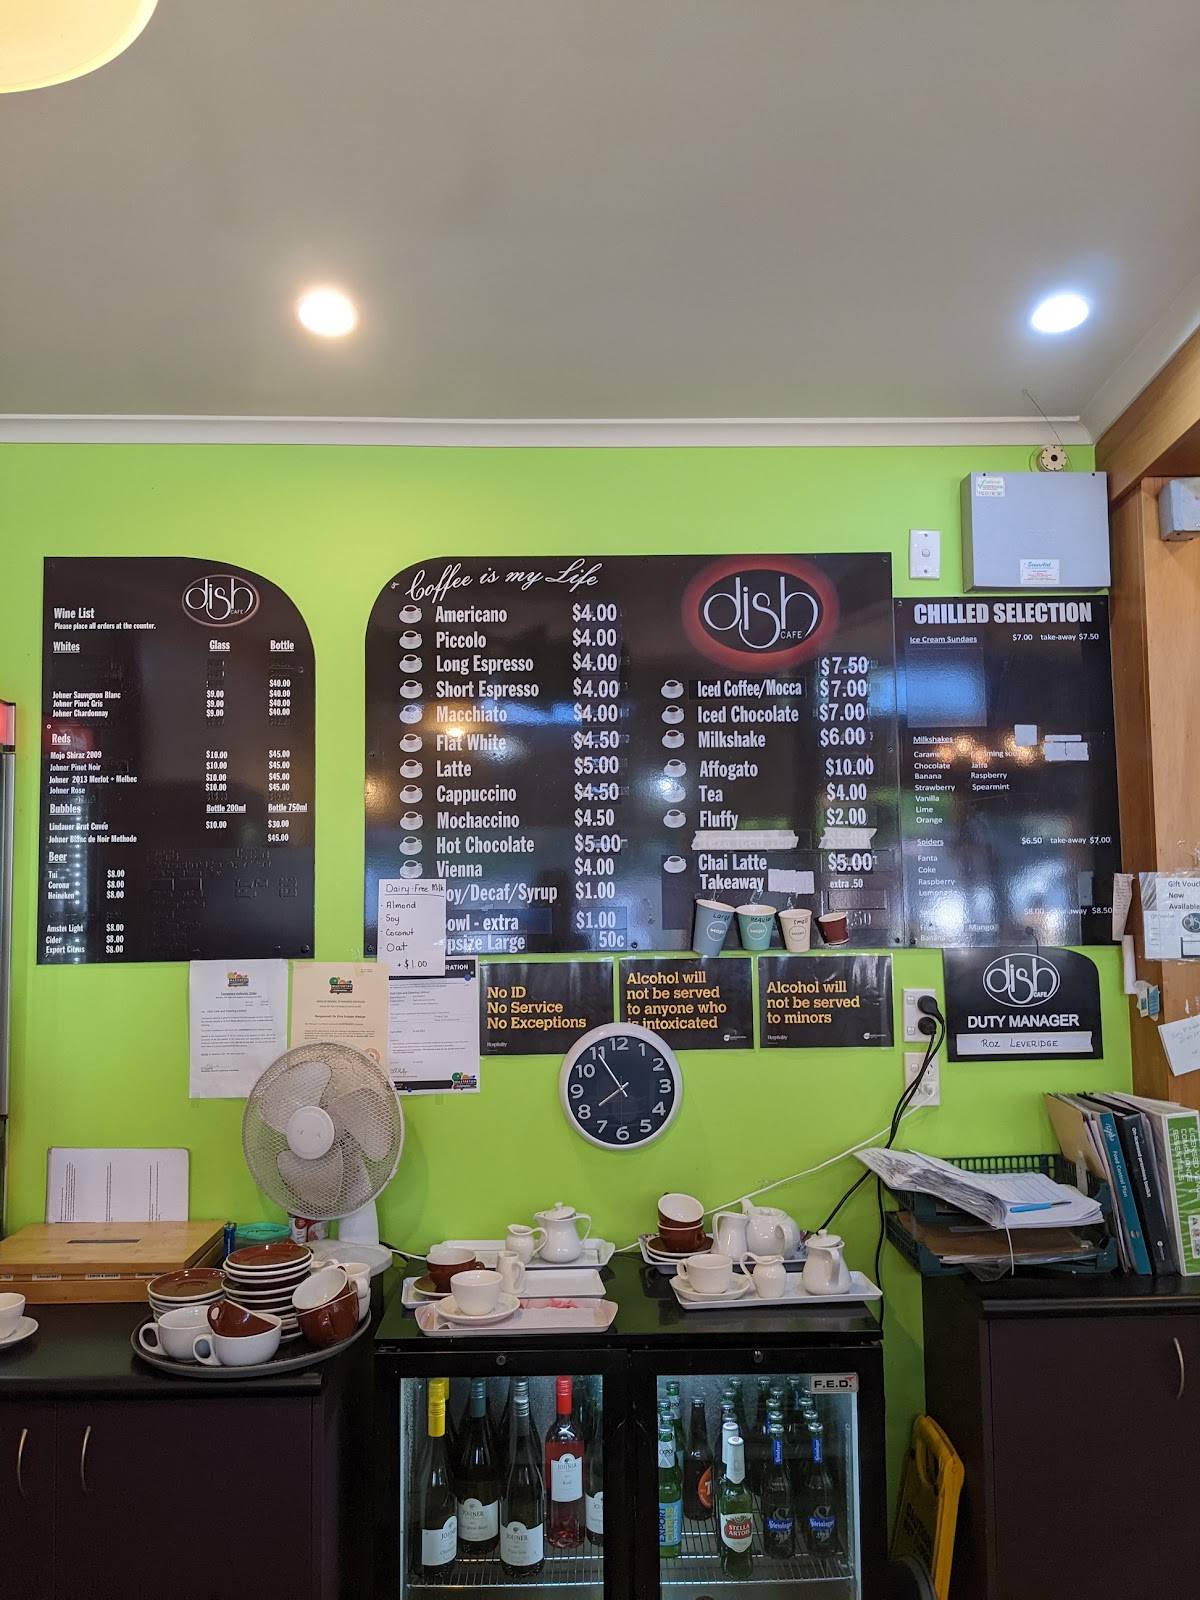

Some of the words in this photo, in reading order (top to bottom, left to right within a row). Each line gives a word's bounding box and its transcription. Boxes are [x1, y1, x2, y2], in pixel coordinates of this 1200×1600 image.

[405, 563, 473, 603] Coffee
[480, 568, 499, 583] is
[505, 569, 543, 590] my
[545, 558, 602, 592] Life
[185, 579, 253, 620] dish
[54, 608, 75, 619] Wine
[78, 608, 94, 619] List
[435, 606, 507, 622] Americano
[573, 604, 616, 621] $4.00
[703, 576, 819, 649] dish
[914, 603, 989, 625] CHILLED
[994, 602, 1092, 624] SELECTION
[73, 623, 88, 631] place
[436, 631, 486, 648] Piccolo
[573, 628, 616, 646] $4.00
[781, 631, 802, 639] CAFE
[1078, 633, 1099, 641] $7.50
[53, 642, 80, 652] Whites
[209, 640, 230, 650] Glass
[270, 640, 294, 650] Bottle
[436, 655, 469, 675] Long
[474, 655, 533, 674] Espresso
[573, 652, 617, 671] $4.00
[436, 680, 474, 697] Short
[479, 680, 539, 700] Espresso
[573, 677, 619, 697] $4.00
[698, 681, 721, 697] Iced
[724, 680, 802, 699] Coffee/Mocca
[53, 700, 72, 708] Johner
[74, 700, 90, 708] Pinot
[91, 700, 103, 708] Gris
[436, 704, 507, 722] Macchiato
[574, 703, 618, 722] $4.00
[698, 706, 726, 723] Iced
[731, 706, 799, 722] Chocolate
[52, 734, 71, 744] Reds
[437, 735, 462, 751] Flat
[466, 734, 506, 751] White
[698, 730, 766, 748] Milkshake
[436, 760, 472, 777] Latte
[700, 760, 758, 780] Affogato
[826, 758, 874, 776] $10.00
[971, 772, 1007, 781] Raspberry
[49, 787, 69, 795] Johner
[699, 785, 723, 802] Tea
[826, 782, 867, 801] $4.00
[915, 784, 955, 792] Strawberry
[972, 783, 1009, 791] Spearmint
[437, 785, 516, 805] Cappuccino
[50, 804, 81, 814] Bubbles
[206, 804, 225, 812] Bottle
[227, 804, 246, 812] 200ml
[437, 811, 519, 829] Mochaccino
[574, 809, 614, 827] $4.50
[700, 810, 738, 830] Fluffy
[826, 807, 866, 825] $2.00
[916, 817, 943, 825] Orange
[436, 837, 461, 854] Hot
[465, 836, 535, 853] Chocolate
[1022, 836, 1042, 845] $6.50
[1050, 836, 1086, 844] take-away
[1090, 836, 1111, 844] $7.00
[49, 852, 67, 862] Beer
[699, 854, 728, 871] Chai
[732, 854, 767, 870] Latte
[49, 870, 58, 878] Tui
[107, 870, 125, 878] $8.00
[436, 860, 482, 878] Vienna
[575, 858, 614, 876] $4.00
[918, 866, 936, 874] Coke
[48, 881, 69, 889] Corona
[107, 881, 124, 889] $8.00
[700, 874, 764, 893] Takeaway
[919, 878, 955, 886] Raspberry
[48, 892, 74, 900] Heineken
[107, 891, 124, 899] $8.00
[576, 881, 616, 900] $1.00
[386, 901, 416, 909] Almond
[386, 915, 400, 925] Soy
[576, 911, 616, 929] $1.00
[106, 924, 124, 932] $8.00
[386, 929, 414, 937] Coconut
[46, 936, 61, 944] Cider
[106, 935, 124, 943] $8.00
[106, 945, 123, 953] $8.00
[386, 943, 407, 952] Oat
[627, 972, 679, 985] Alcohol
[682, 971, 706, 984] will
[987, 958, 1057, 1004] dish
[487, 986, 508, 999] No
[510, 986, 526, 999] ID
[627, 988, 649, 1000] not
[652, 986, 670, 1000] be
[673, 986, 720, 999] served
[766, 982, 819, 994] Alcohol
[821, 980, 847, 993] will
[487, 1002, 508, 1014] No
[510, 1001, 563, 1014] Service
[627, 1003, 641, 1015] to
[644, 1002, 695, 1018] anyone
[698, 1000, 727, 1014] who
[766, 996, 789, 1009] not
[792, 996, 811, 1009] be
[813, 996, 860, 1008] served
[486, 1017, 508, 1029] No
[510, 1016, 587, 1031] Exceptions
[642, 1016, 718, 1030] intoxicated
[767, 1011, 781, 1024] to
[783, 1011, 832, 1025] minors
[968, 1015, 1004, 1028] DUTY
[1009, 1015, 1080, 1027] MANAGER
[609, 1037, 629, 1050] 12
[639, 1043, 645, 1056] 1
[981, 1039, 1000, 1048] Roz
[1010, 1039, 1058, 1047] LEVERIDGE
[589, 1046, 606, 1060] 11
[576, 1064, 595, 1078] 10
[653, 1058, 665, 1071] 2
[570, 1084, 584, 1099] 9
[659, 1079, 671, 1094] 3
[578, 1104, 591, 1119] 8
[652, 1102, 666, 1116] 4
[597, 1120, 608, 1133] 7
[640, 1119, 651, 1133] 5
[616, 1126, 630, 1141] 6
[814, 1380, 852, 1388] F.E.D.
